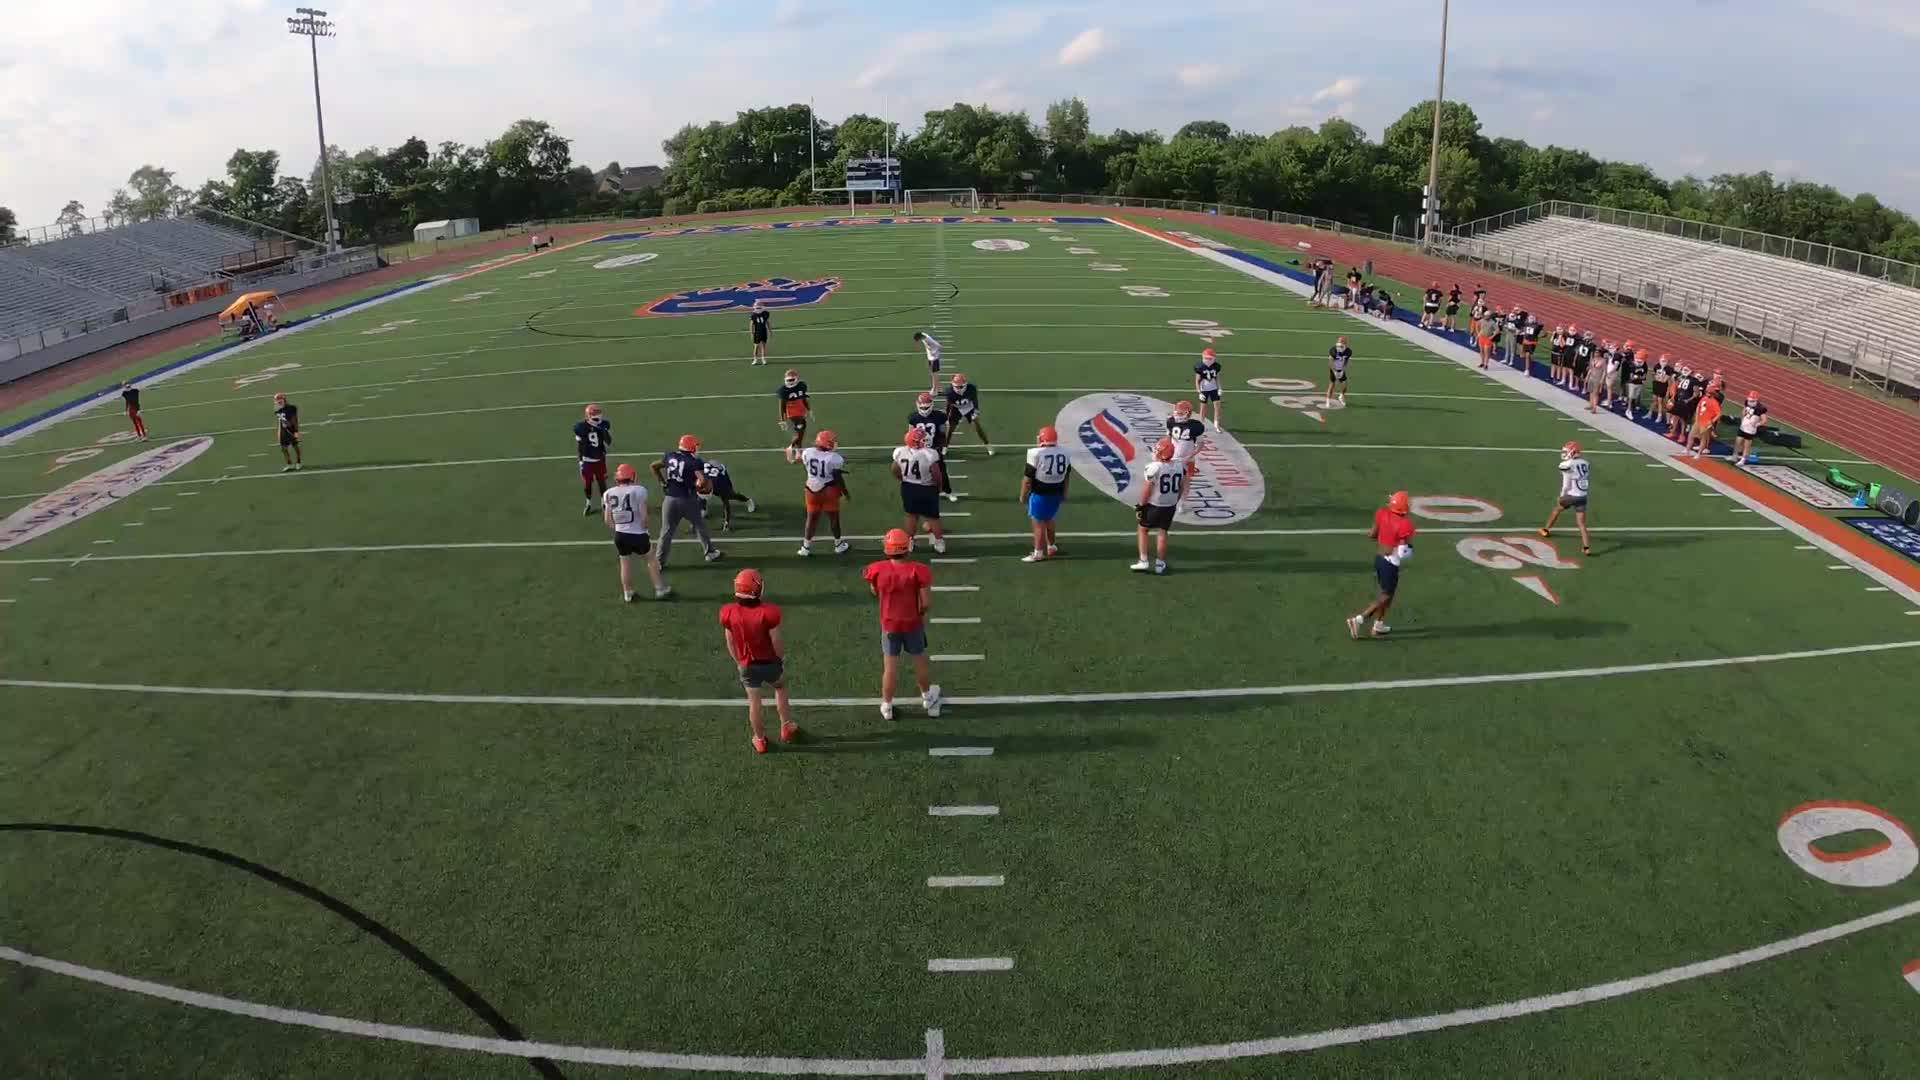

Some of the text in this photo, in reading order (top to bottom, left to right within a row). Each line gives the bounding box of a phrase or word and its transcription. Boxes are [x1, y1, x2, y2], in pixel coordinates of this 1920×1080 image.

[588, 431, 599, 447] 9
[667, 458, 684, 482] 21
[901, 458, 922, 480] 74
[1044, 453, 1066, 475] 78
[1159, 473, 1182, 494] 60
[608, 493, 633, 512] 24
